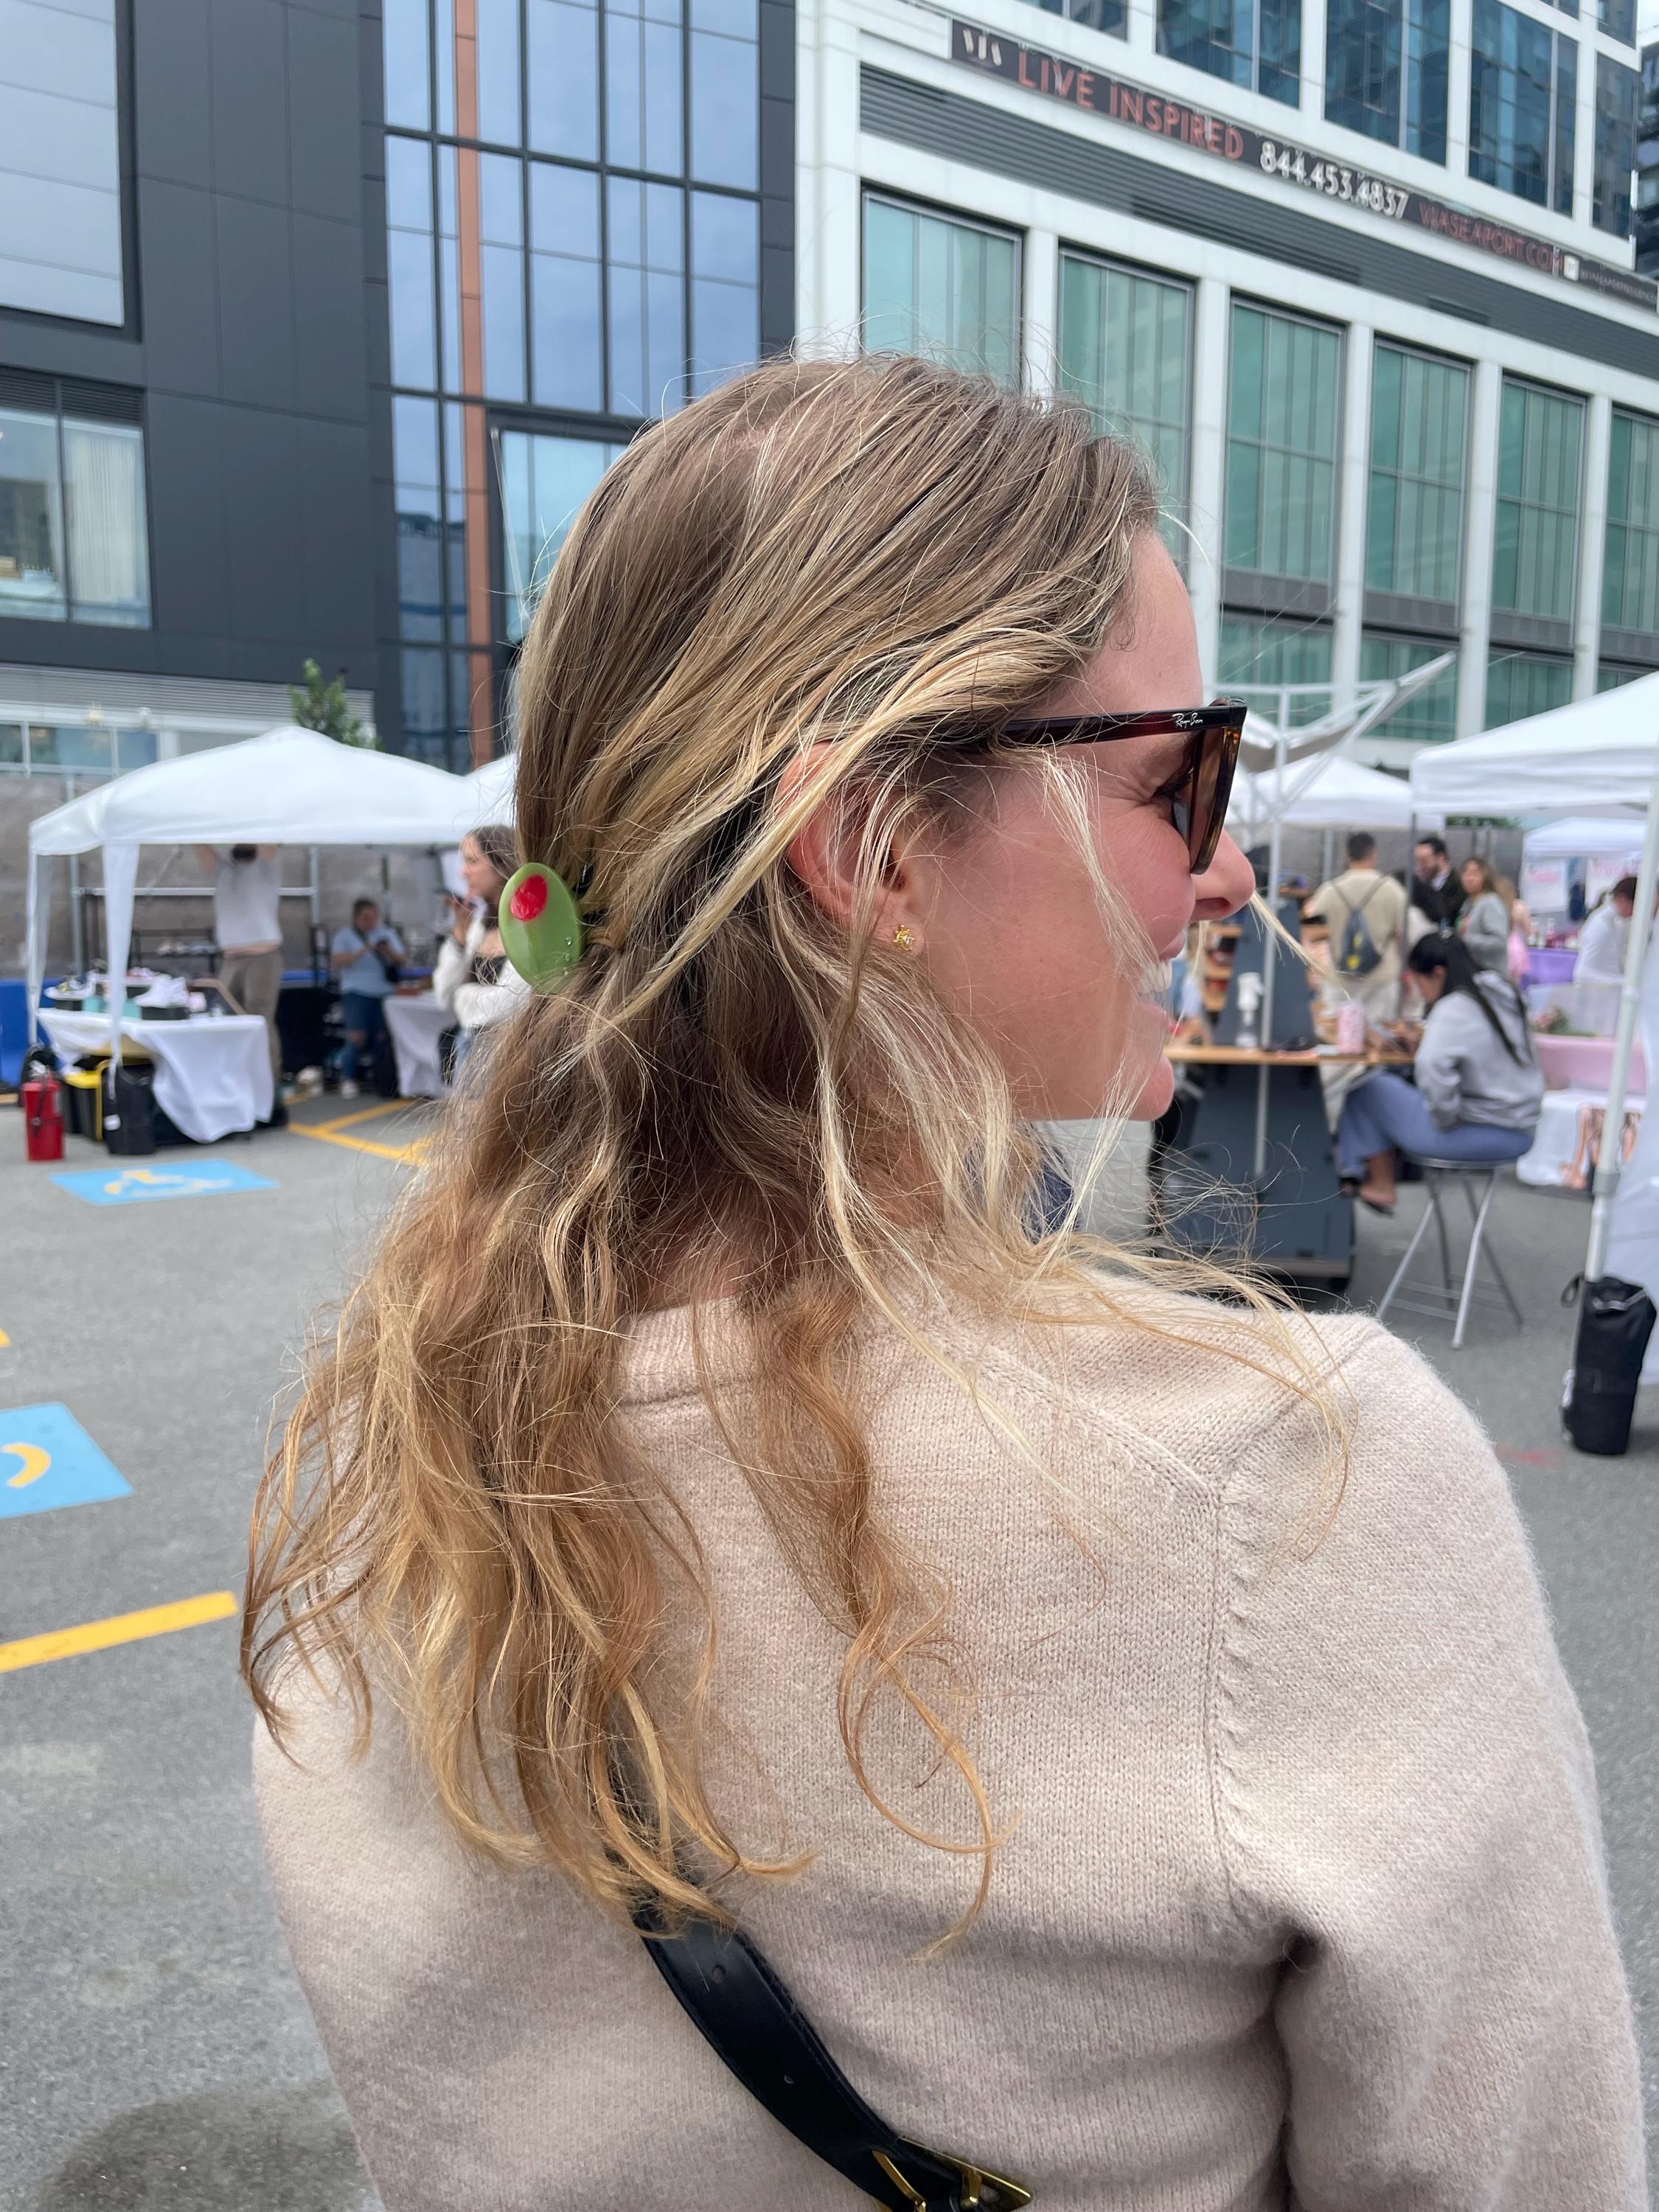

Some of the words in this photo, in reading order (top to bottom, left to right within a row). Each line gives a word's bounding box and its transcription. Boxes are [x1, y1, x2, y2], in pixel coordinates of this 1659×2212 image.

[1018, 50, 1094, 108] LIVE
[1109, 83, 1244, 160] INSPIRED
[1259, 140, 1410, 220] 844.453.4837
[1172, 712, 1203, 729] Ray-Ban
